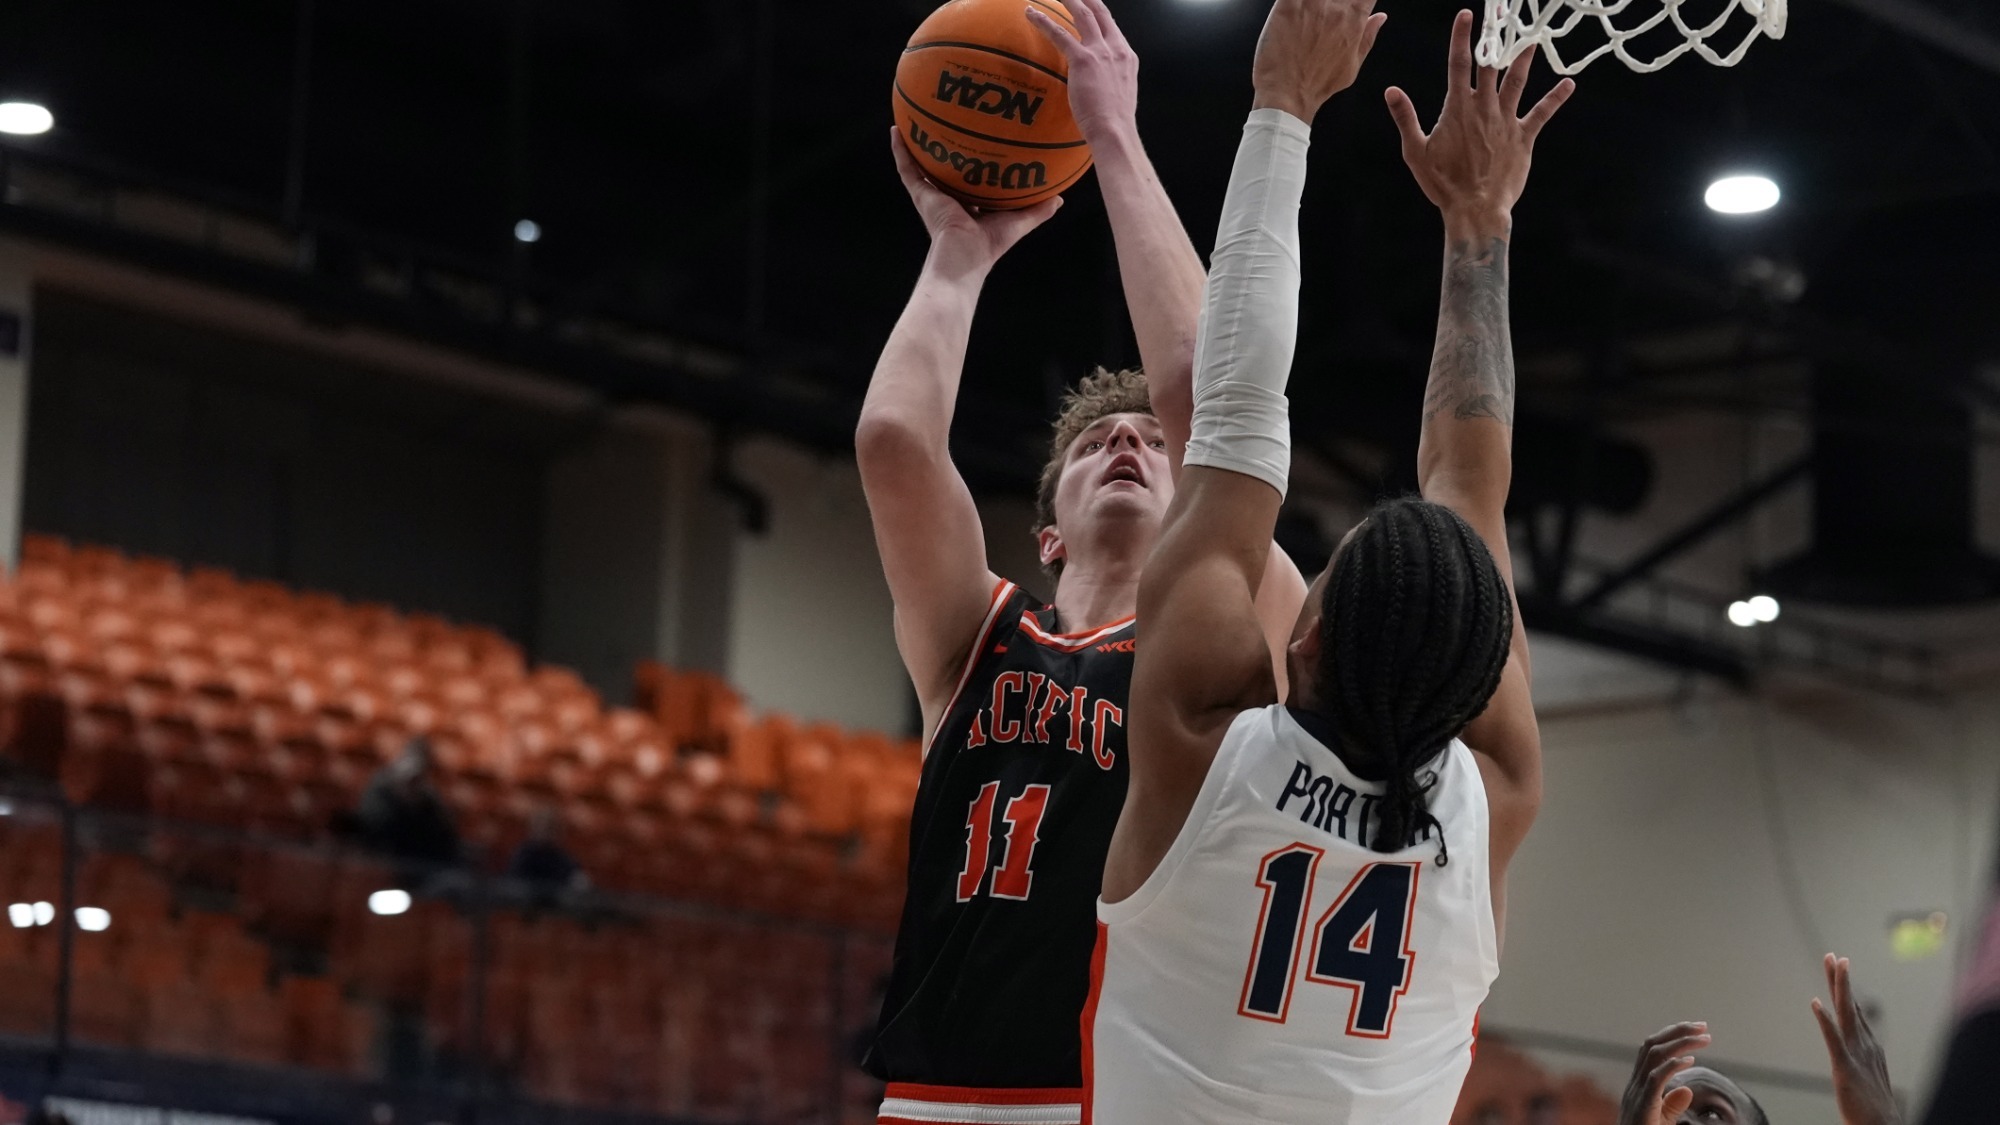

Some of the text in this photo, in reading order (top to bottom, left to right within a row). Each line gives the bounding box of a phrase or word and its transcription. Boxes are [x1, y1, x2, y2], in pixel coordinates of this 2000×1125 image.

[936, 70, 1044, 126] NCAA
[909, 120, 1047, 190] Wilson
[956, 780, 1051, 903] 11
[1275, 759, 1430, 848] PORT
[1237, 841, 1422, 1039] 14
